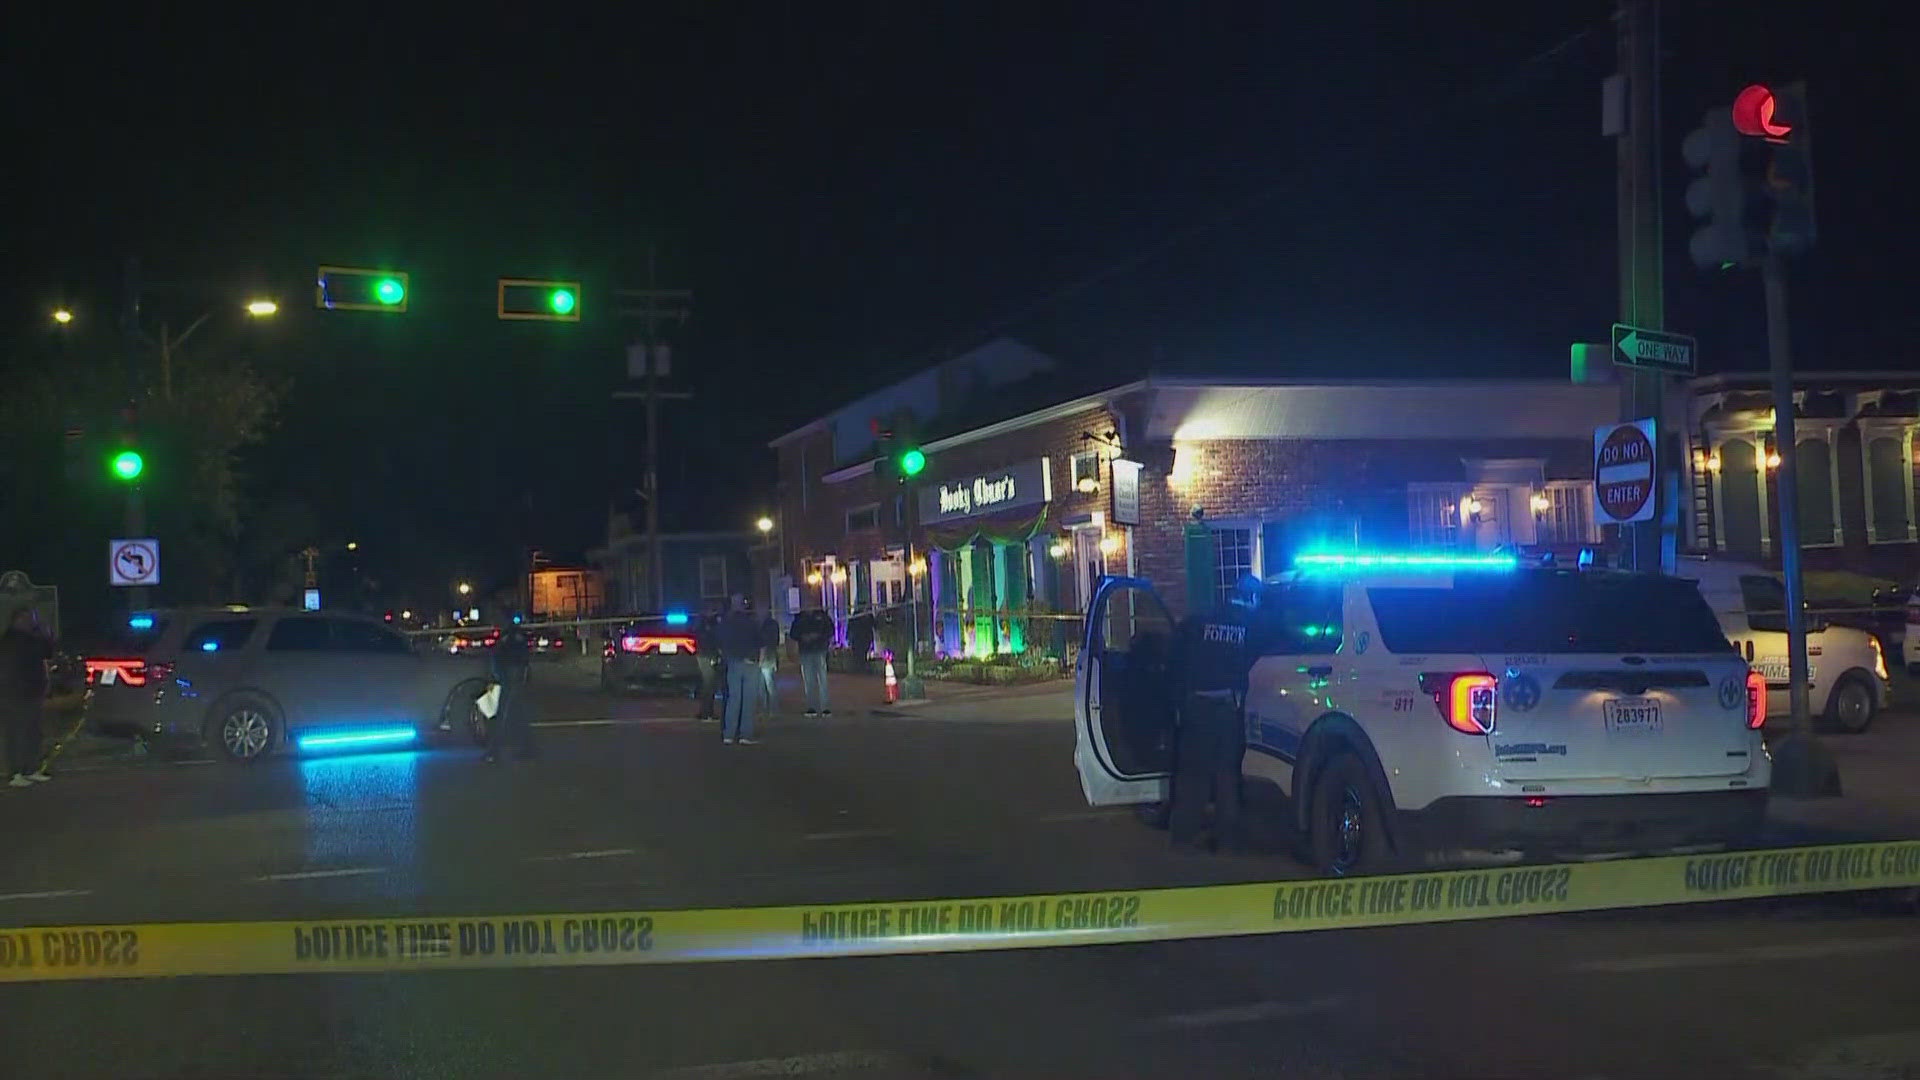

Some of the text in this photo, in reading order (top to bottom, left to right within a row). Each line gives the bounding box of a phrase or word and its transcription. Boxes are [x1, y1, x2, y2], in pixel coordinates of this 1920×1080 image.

[1637, 341, 1686, 362] ONE WAY
[1604, 441, 1645, 463] DO NOT
[1607, 486, 1640, 504] ENTER
[1203, 629, 1246, 645] POLICE
[1394, 697, 1414, 712] 911
